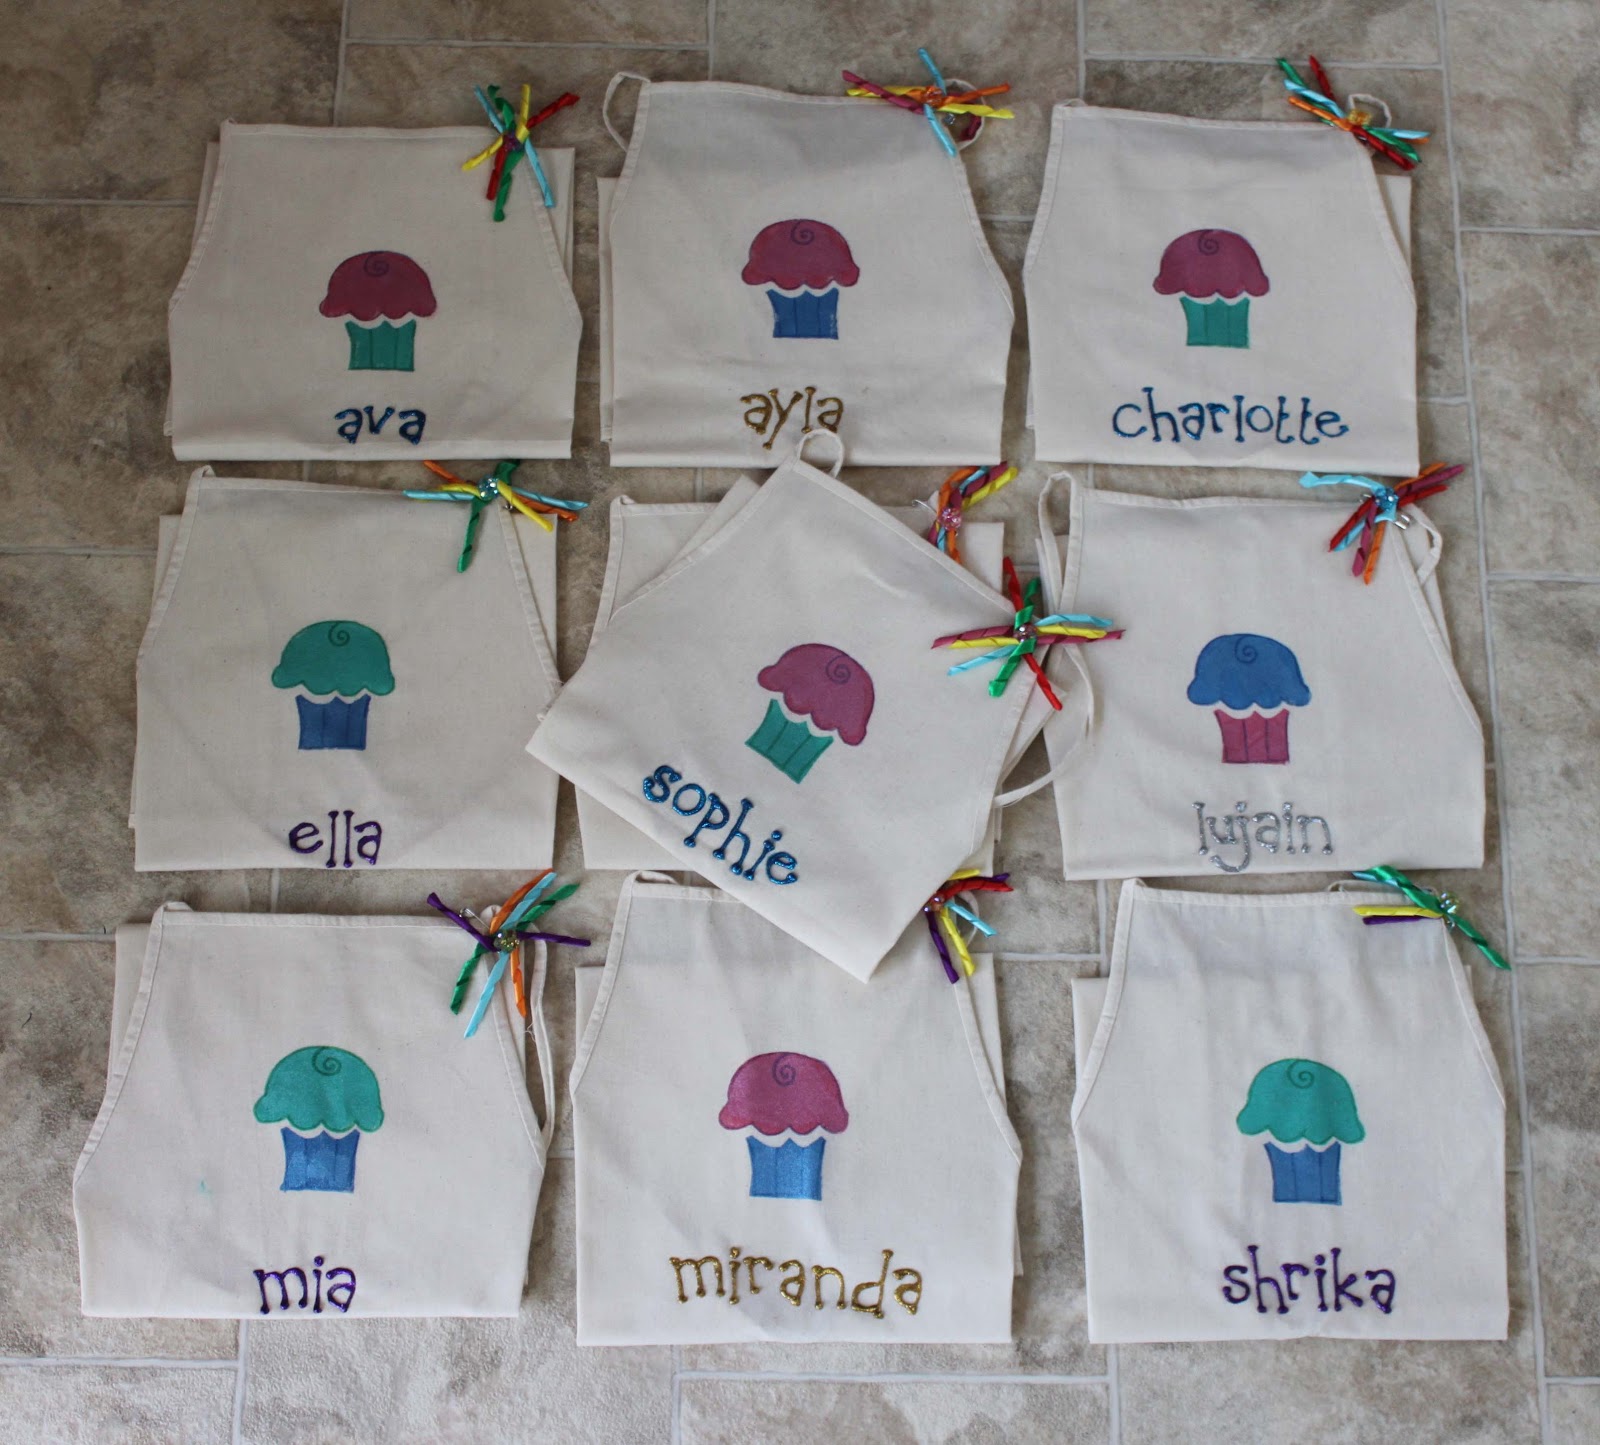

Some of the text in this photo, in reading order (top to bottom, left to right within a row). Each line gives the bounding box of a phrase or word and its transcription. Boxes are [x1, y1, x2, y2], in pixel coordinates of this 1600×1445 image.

[335, 406, 427, 446] ava
[740, 386, 845, 450] ayla
[1111, 387, 1350, 446] charlotte
[288, 809, 383, 867] ella
[642, 763, 799, 886] sophie
[1194, 801, 1334, 873] lujain
[253, 1255, 357, 1315] mia
[668, 1246, 923, 1320] miranda
[1221, 1245, 1397, 1315] shrika
